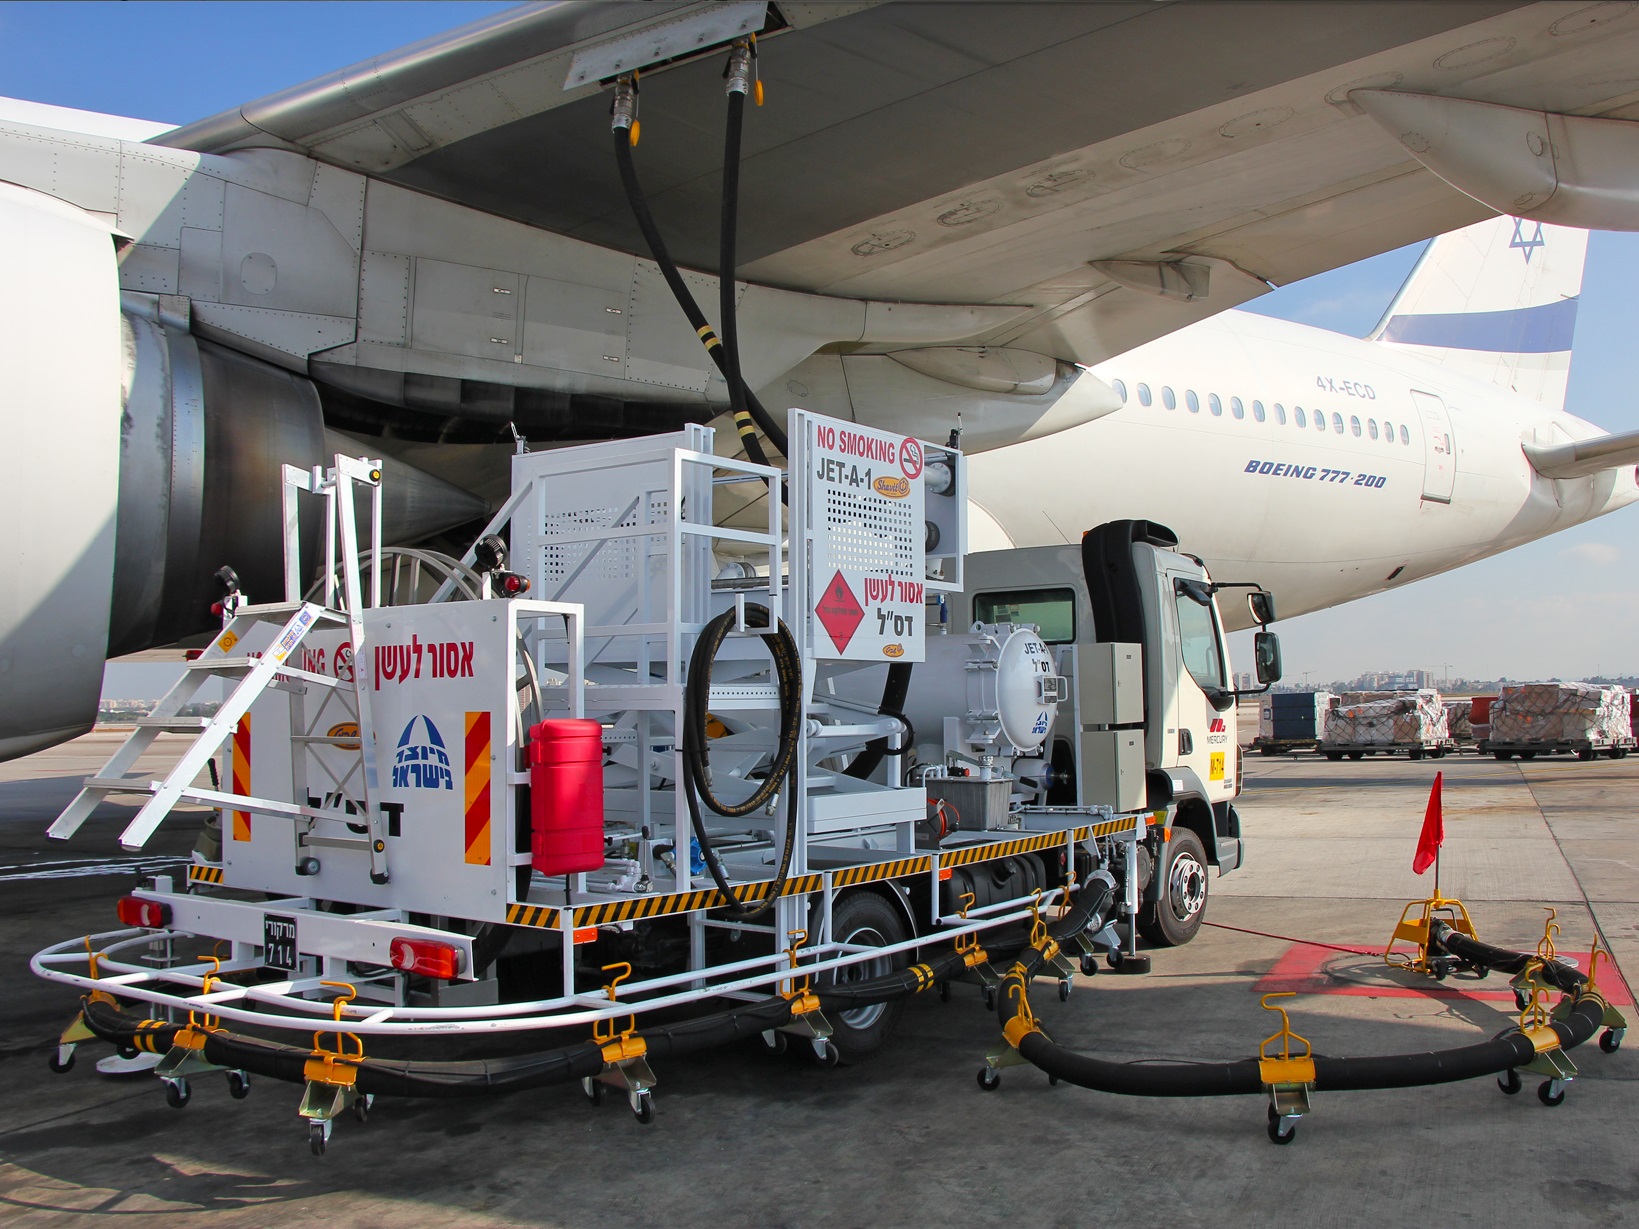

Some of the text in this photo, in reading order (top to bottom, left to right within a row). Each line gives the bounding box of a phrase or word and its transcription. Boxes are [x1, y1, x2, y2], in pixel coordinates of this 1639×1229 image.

[1316, 375, 1376, 400] 4X-ECD
[817, 424, 895, 465] NO SMOKING
[816, 457, 872, 490] JET-A-1
[1244, 459, 1317, 480] BOEING
[864, 573, 924, 607] אסור לעשן
[374, 634, 422, 691] לעשן
[428, 641, 474, 679] אסור
[1206, 735, 1228, 744] MERCURY
[265, 920, 296, 940] מרקורי
[268, 943, 293, 967] 714
